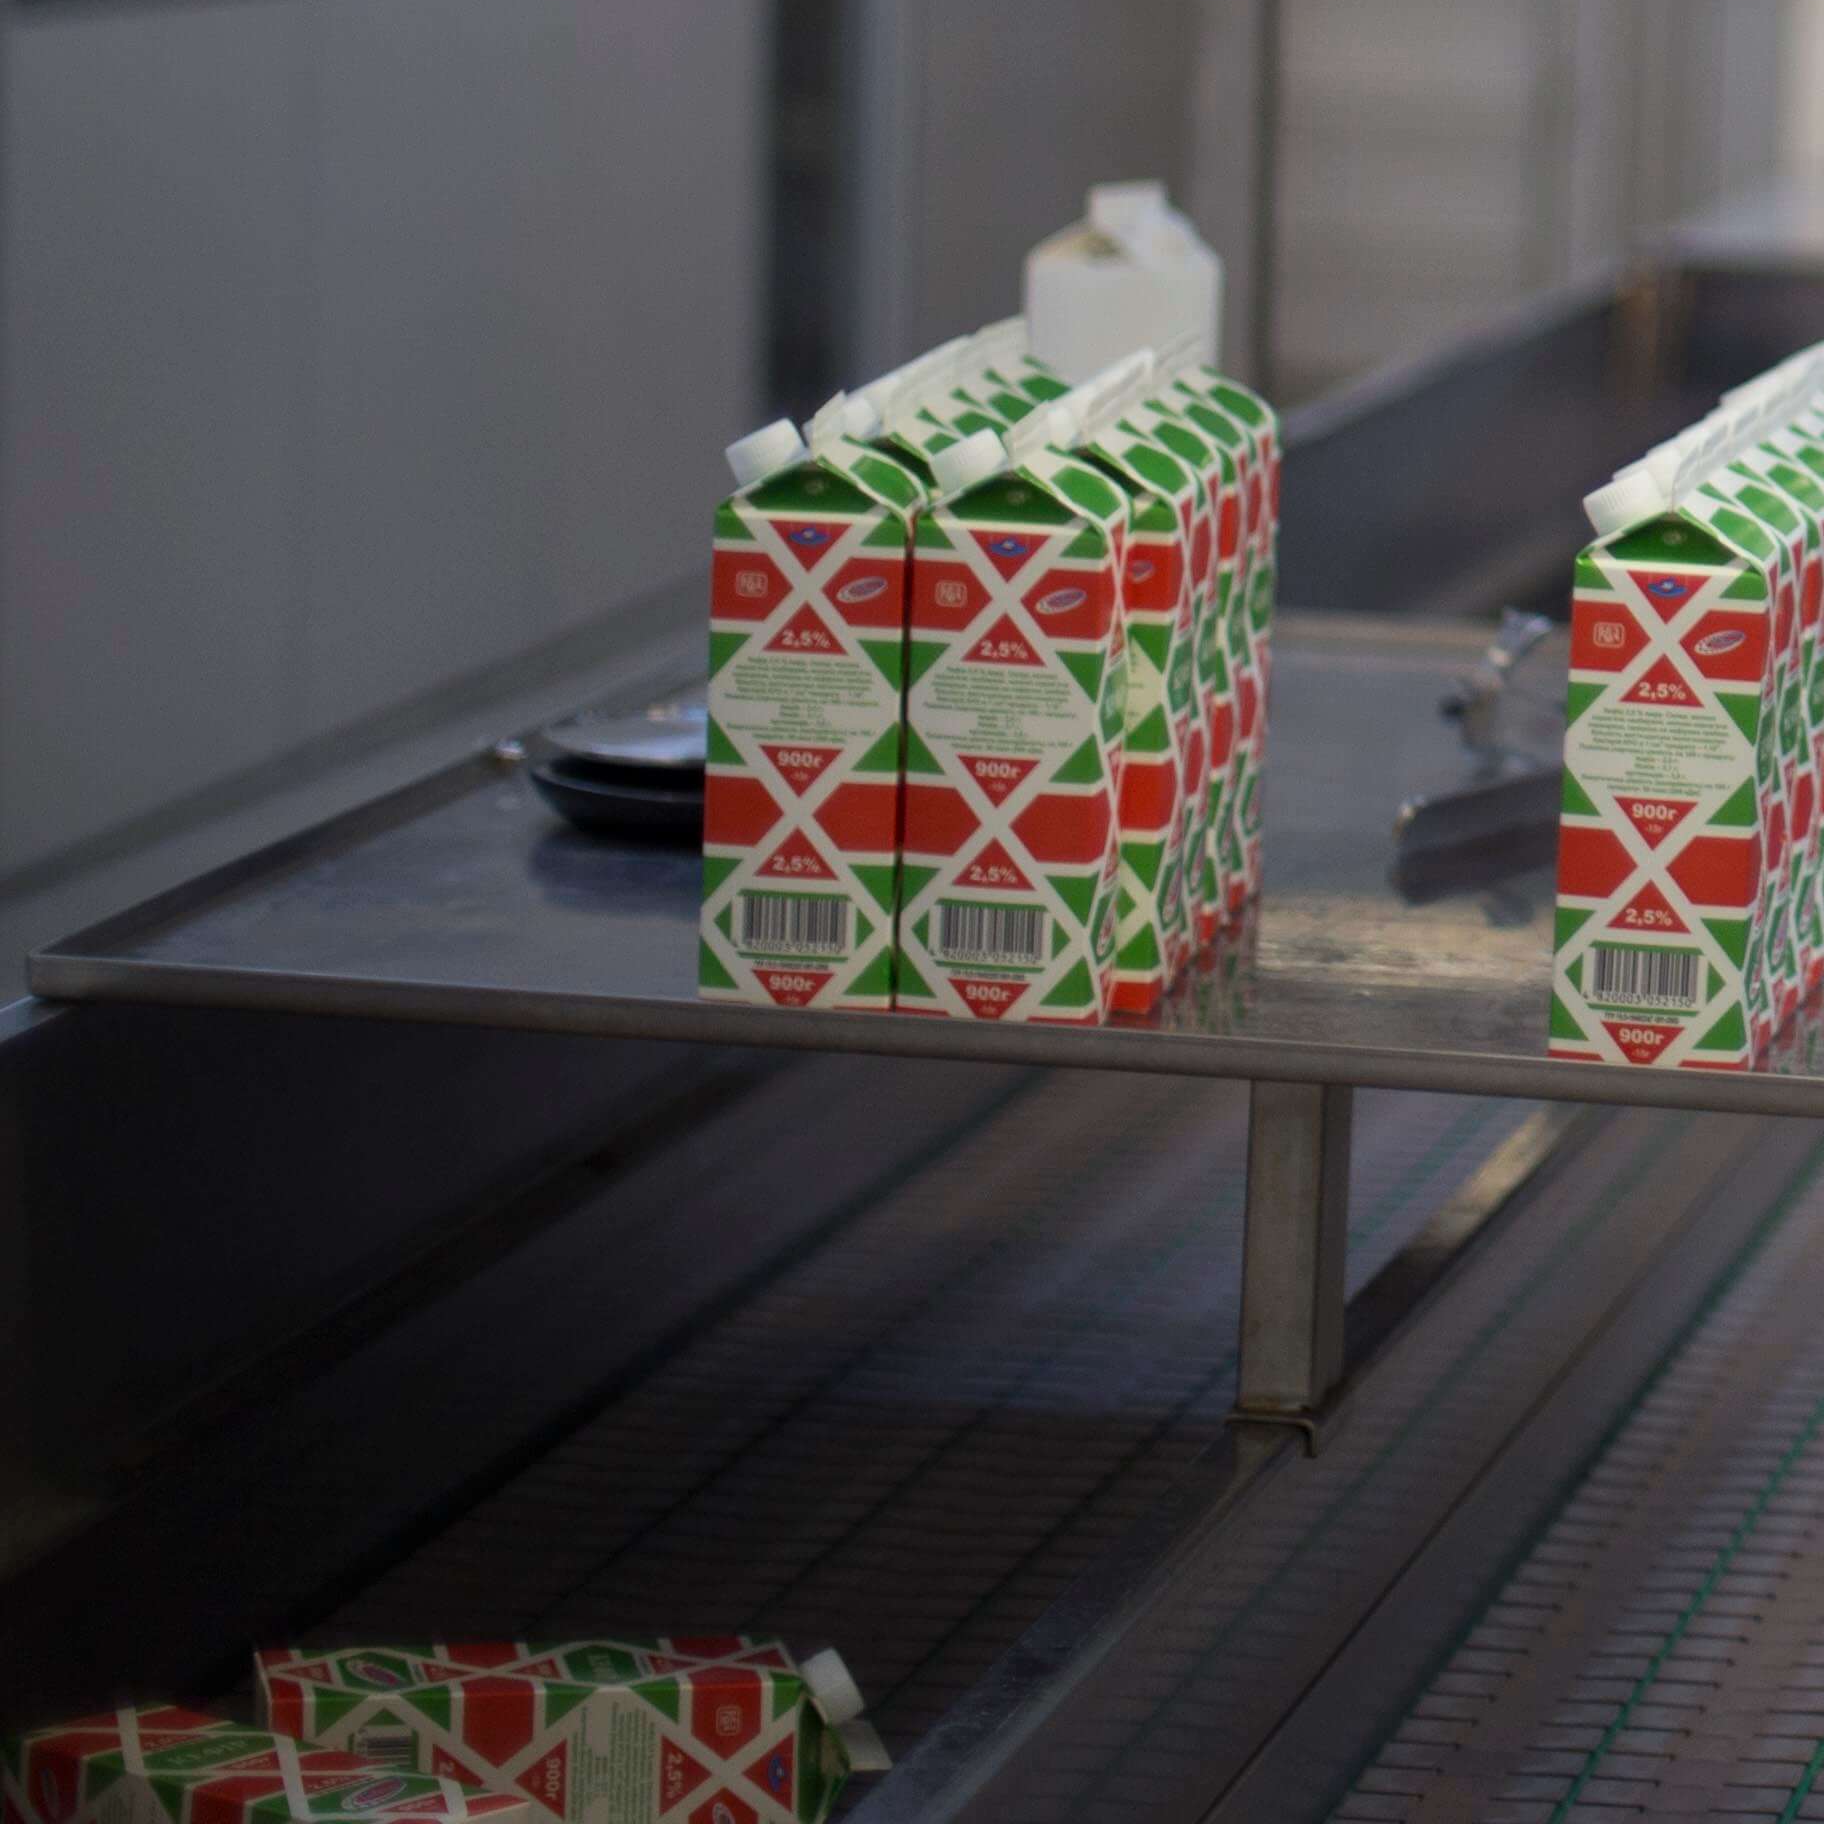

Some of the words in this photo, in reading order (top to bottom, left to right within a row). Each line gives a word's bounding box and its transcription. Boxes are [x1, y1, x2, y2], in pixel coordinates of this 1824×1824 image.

[782, 629, 831, 649] 2,5%
[979, 640, 1028, 659] 2,5%
[1638, 682, 1687, 701] 2,5%
[772, 855, 821, 873] 2,5%
[970, 865, 1018, 883] 2,5%
[1625, 908, 1673, 926] 2,5%
[666, 1753, 684, 1800] 2,5%
